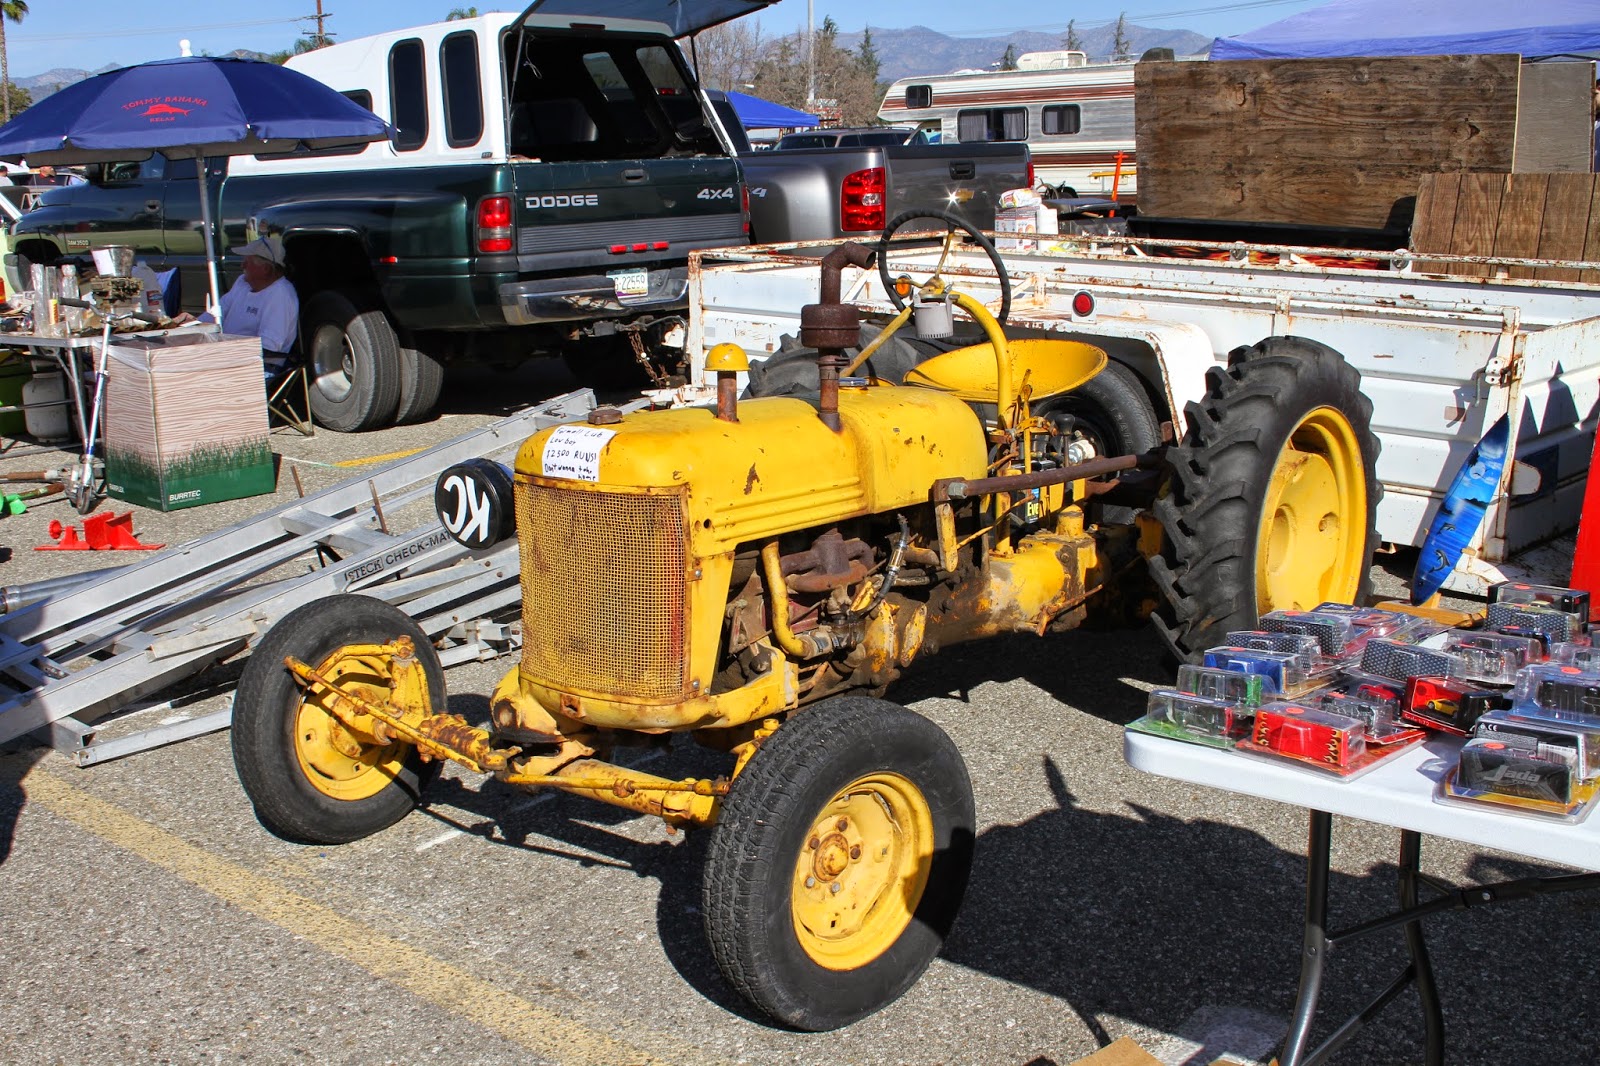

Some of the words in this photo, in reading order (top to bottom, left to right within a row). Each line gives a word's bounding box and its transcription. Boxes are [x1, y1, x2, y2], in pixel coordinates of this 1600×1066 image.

[525, 194, 599, 209] DODGE
[169, 489, 201, 502] BURRTEC
[347, 560, 382, 580] STECK
[385, 530, 452, 565] CHECK-MAT
[1483, 764, 1541, 782] Jada
